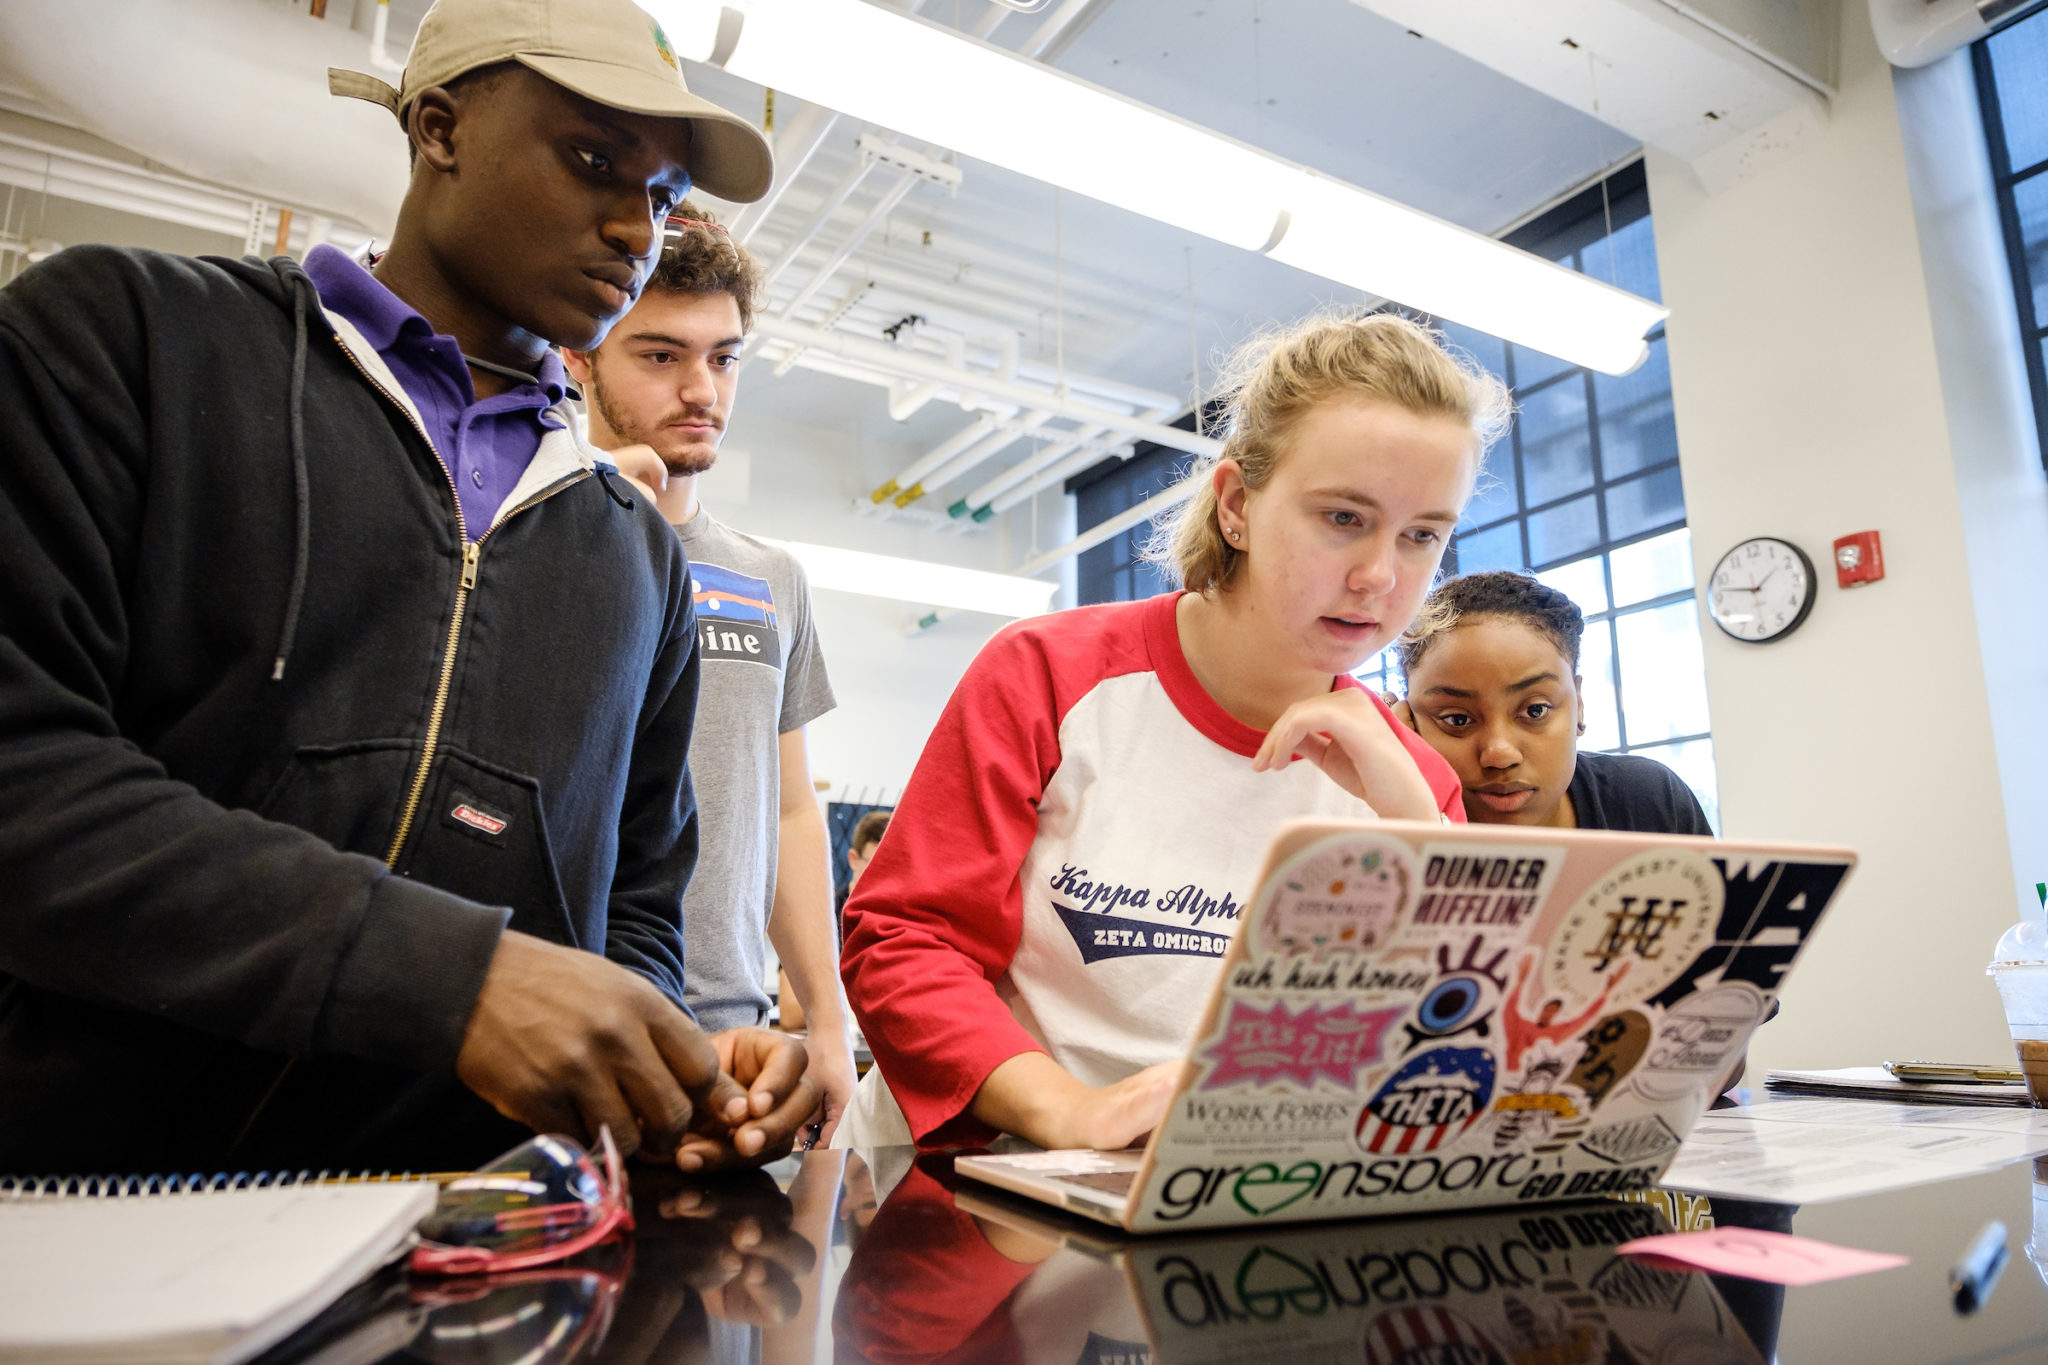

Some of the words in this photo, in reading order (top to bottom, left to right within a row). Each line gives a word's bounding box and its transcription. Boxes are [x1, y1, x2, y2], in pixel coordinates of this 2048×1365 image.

[1746, 544, 1761, 558] 12
[700, 625, 761, 655] ine
[1424, 855, 1547, 890] DUNDER
[1050, 863, 1150, 914] Kappa
[1093, 929, 1147, 948] ZETA
[1233, 958, 1273, 989] uh
[1283, 958, 1342, 989] huh
[1273, 1102, 1350, 1123] FORES
[1379, 1088, 1475, 1127] THETA
[1517, 1173, 1565, 1199] GO
